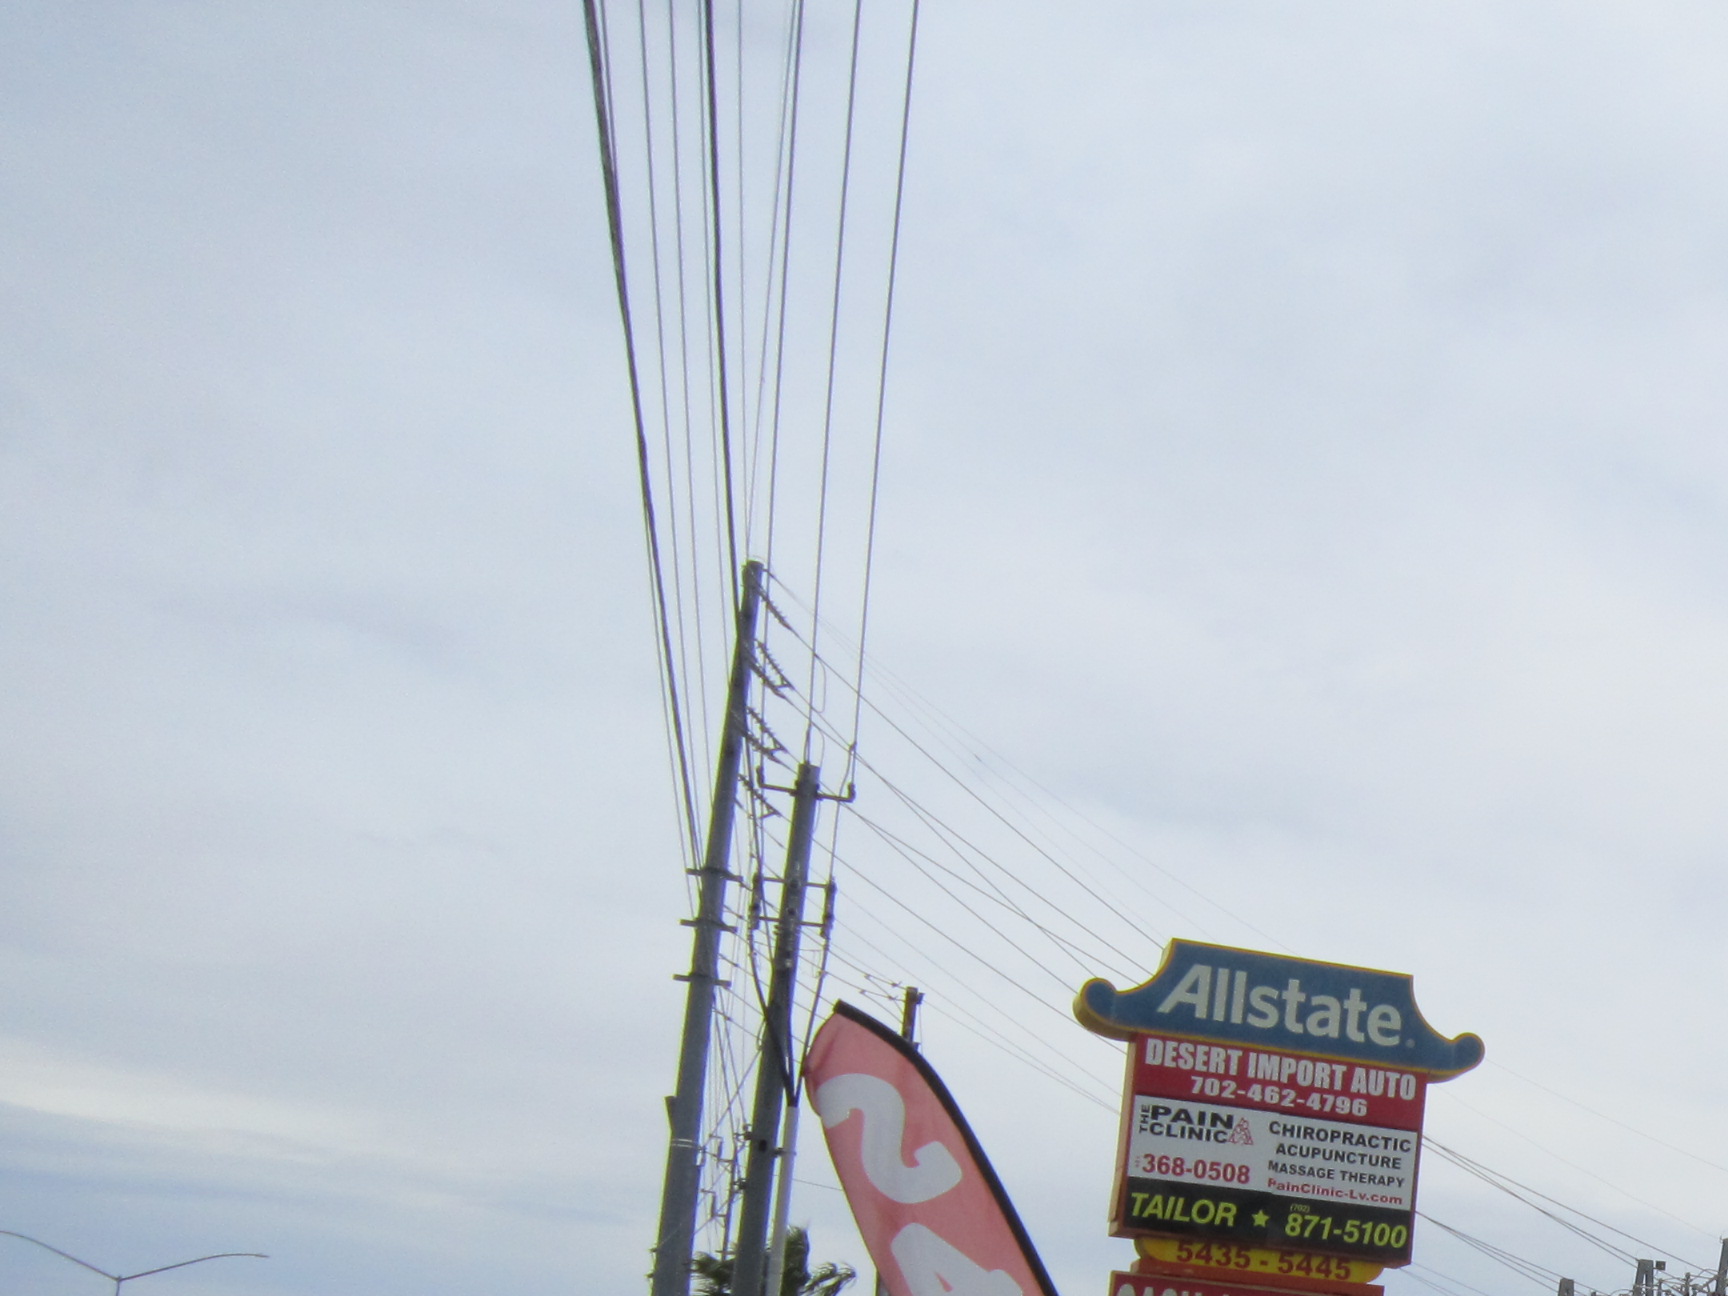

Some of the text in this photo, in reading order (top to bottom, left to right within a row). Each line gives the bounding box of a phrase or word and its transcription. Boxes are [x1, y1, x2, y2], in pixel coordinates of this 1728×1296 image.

[1158, 963, 1402, 1048] Allstate
[1145, 1037, 1417, 1101] DESERT IMPORT AUTO
[1190, 1075, 1368, 1117] 702-462-4796
[1139, 1104, 1150, 1133] THE
[1149, 1122, 1228, 1143] CLINIC
[1150, 1105, 1235, 1130] PAIN
[1269, 1120, 1412, 1153] CHIROPRACTIC
[1142, 1153, 1250, 1184] 368-0508
[1275, 1143, 1402, 1170] ACUPUNCTURE
[1267, 1160, 1405, 1188] MASSAGE THERAPY
[1267, 1177, 1403, 1205] PainClinic-Lv.com
[1130, 1192, 1408, 1248] TAILOR 871-5100
[1176, 1241, 1251, 1269] 5435
[1277, 1251, 1351, 1281] 5445
